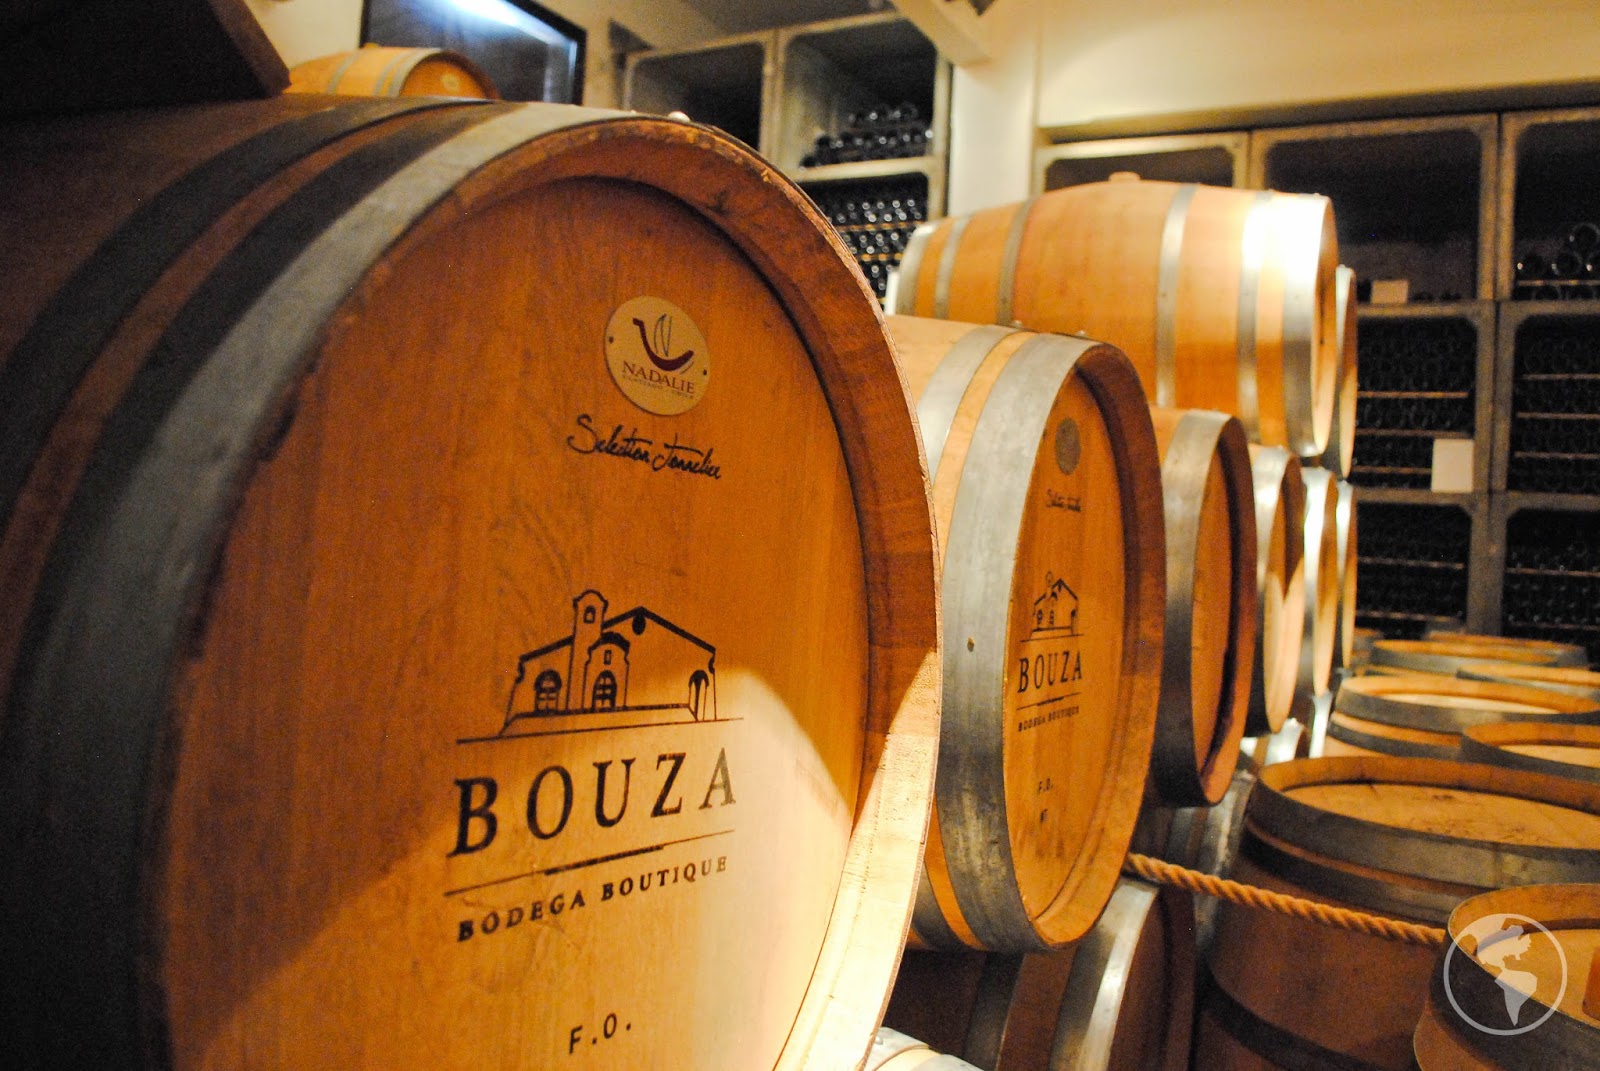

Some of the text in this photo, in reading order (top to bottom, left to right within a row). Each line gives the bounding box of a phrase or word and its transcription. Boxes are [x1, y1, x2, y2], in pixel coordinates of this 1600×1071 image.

[622, 360, 695, 394] NADALIE
[1017, 649, 1083, 694] BOUZA
[446, 747, 737, 858] BOUZA
[457, 856, 728, 943] BODEGA BOUTIQUE
